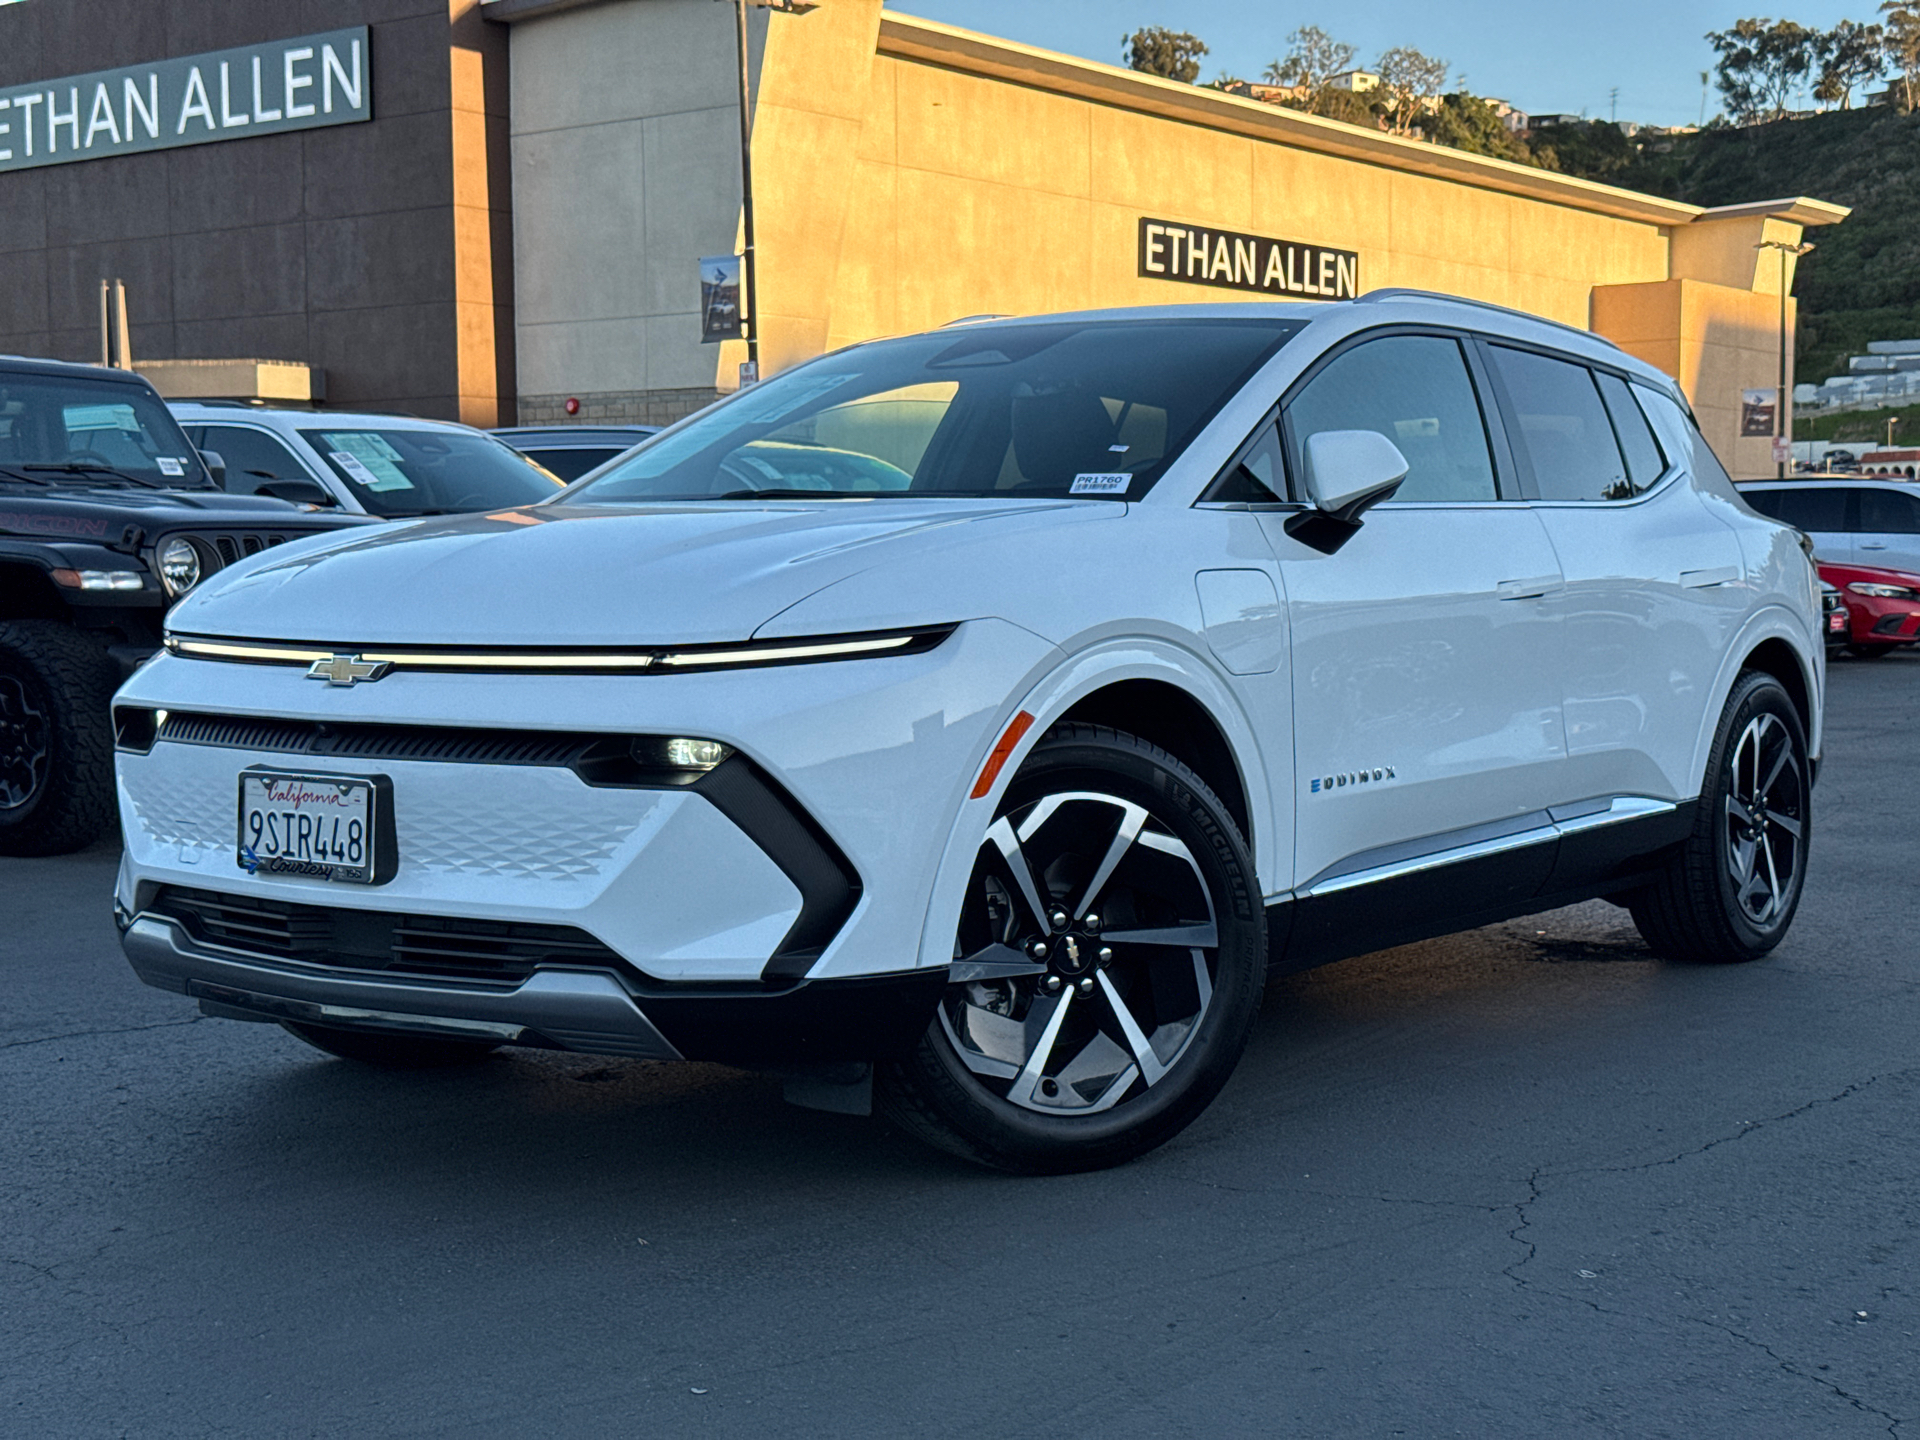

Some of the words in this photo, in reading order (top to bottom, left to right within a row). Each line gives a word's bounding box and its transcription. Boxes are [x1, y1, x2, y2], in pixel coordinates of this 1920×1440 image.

[176, 39, 361, 135] ALLEN
[1146, 224, 1256, 286] ETHAN
[1263, 244, 1356, 299] ALLEN
[1076, 476, 1122, 484] PR1760
[268, 781, 349, 810] California
[1310, 766, 1395, 793] EQUINOX
[249, 809, 363, 863] 9SIR448
[269, 856, 334, 881] Courtesy
[1190, 807, 1251, 916] MICHELIN
